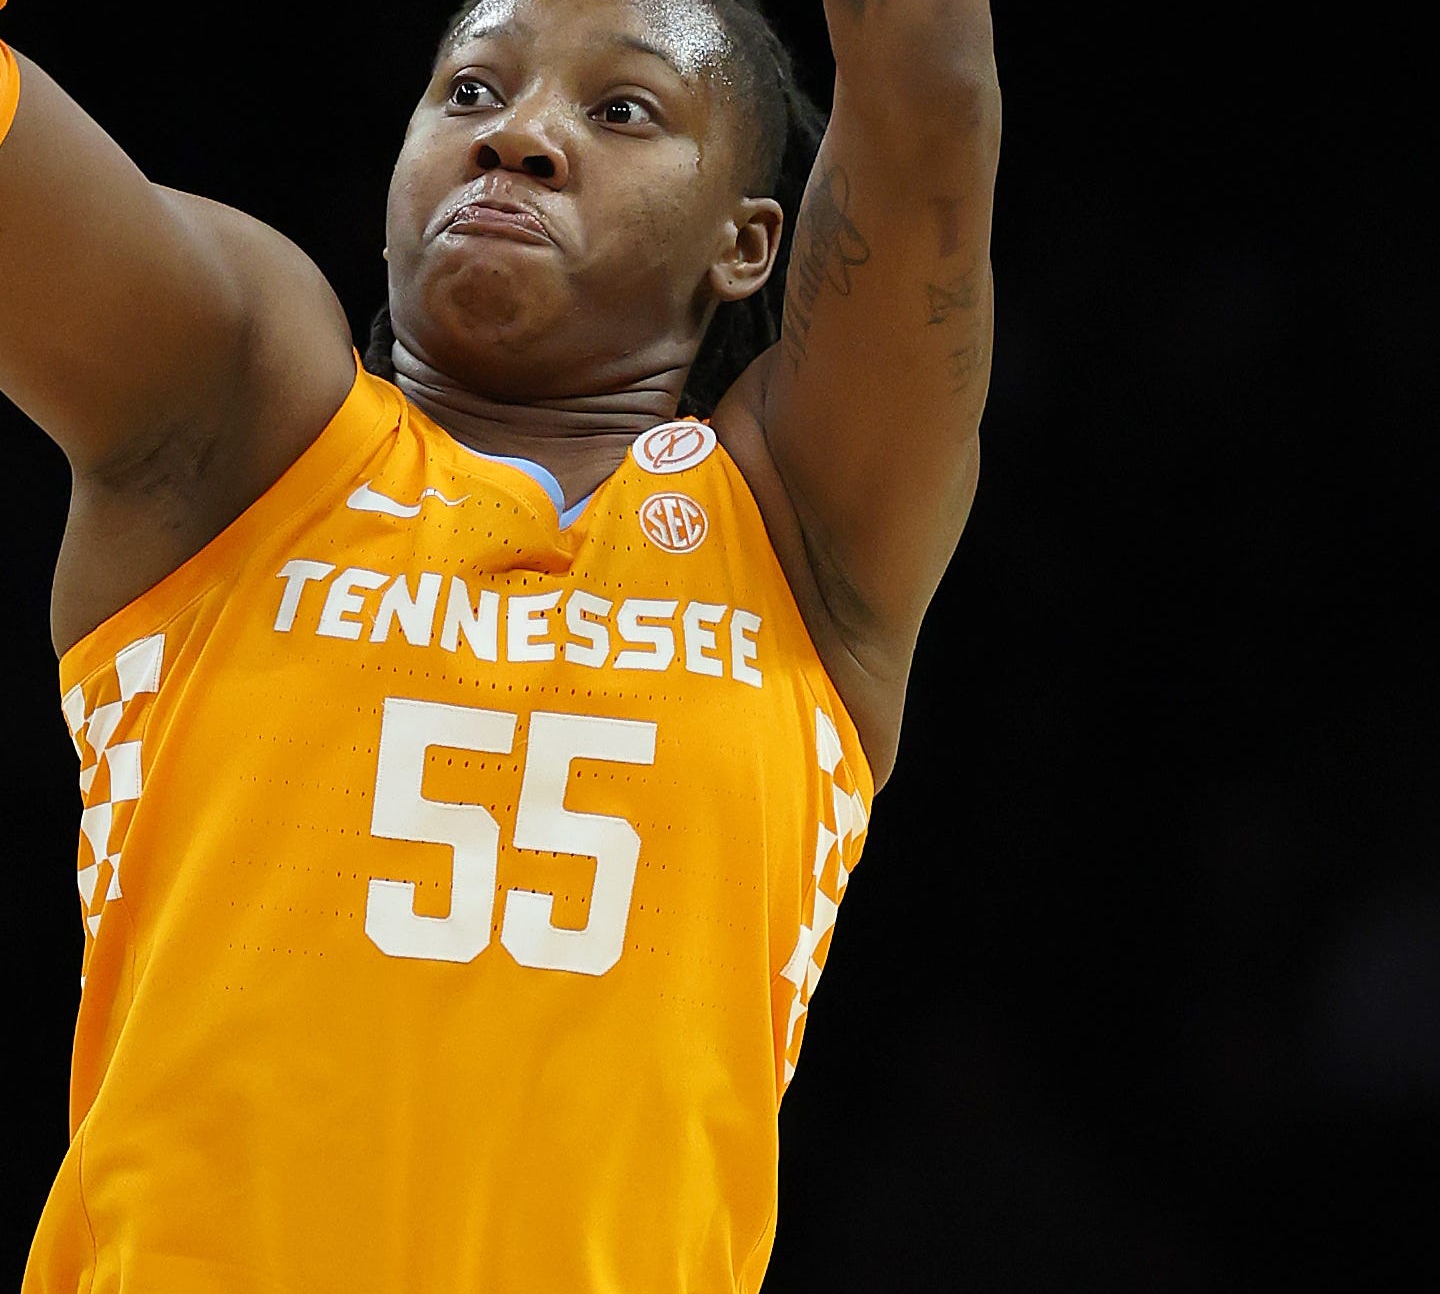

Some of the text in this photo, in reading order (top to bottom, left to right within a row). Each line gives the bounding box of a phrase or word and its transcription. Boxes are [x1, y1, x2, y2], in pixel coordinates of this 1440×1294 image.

[645, 497, 702, 548] SEC
[273, 558, 763, 689] TENNESSEE
[364, 696, 658, 977] 55
